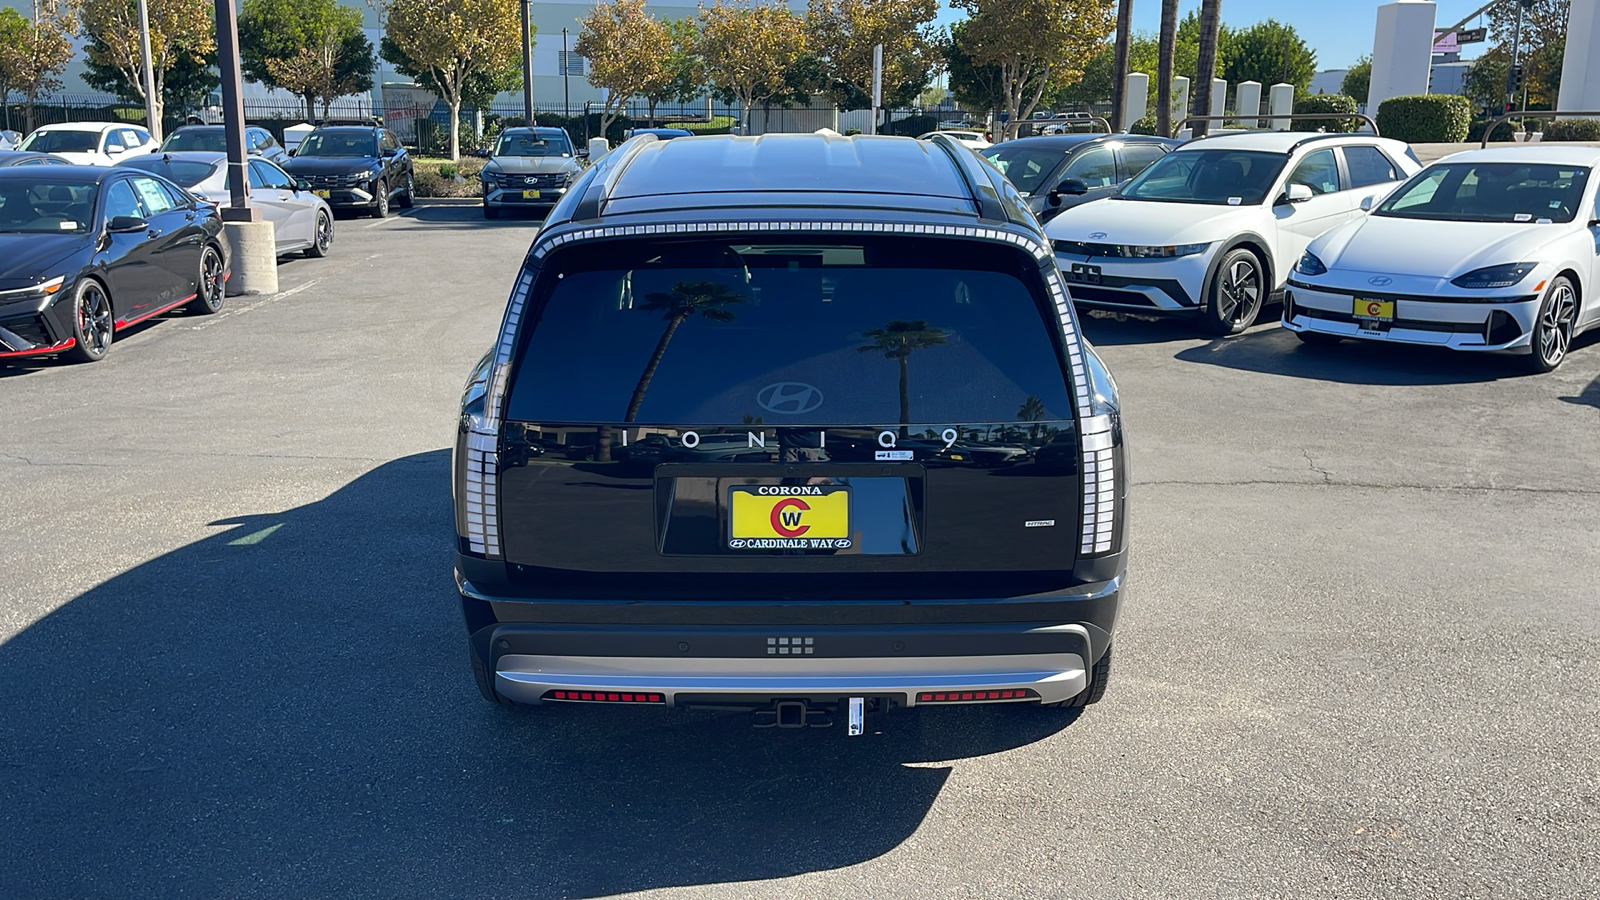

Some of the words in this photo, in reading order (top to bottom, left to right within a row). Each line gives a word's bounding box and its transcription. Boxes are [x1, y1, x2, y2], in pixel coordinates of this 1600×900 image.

[758, 486, 822, 495] CORONA
[770, 497, 811, 538] C
[781, 509, 803, 527] W
[747, 539, 808, 549] CARDINALE
[810, 539, 834, 549] WAY
